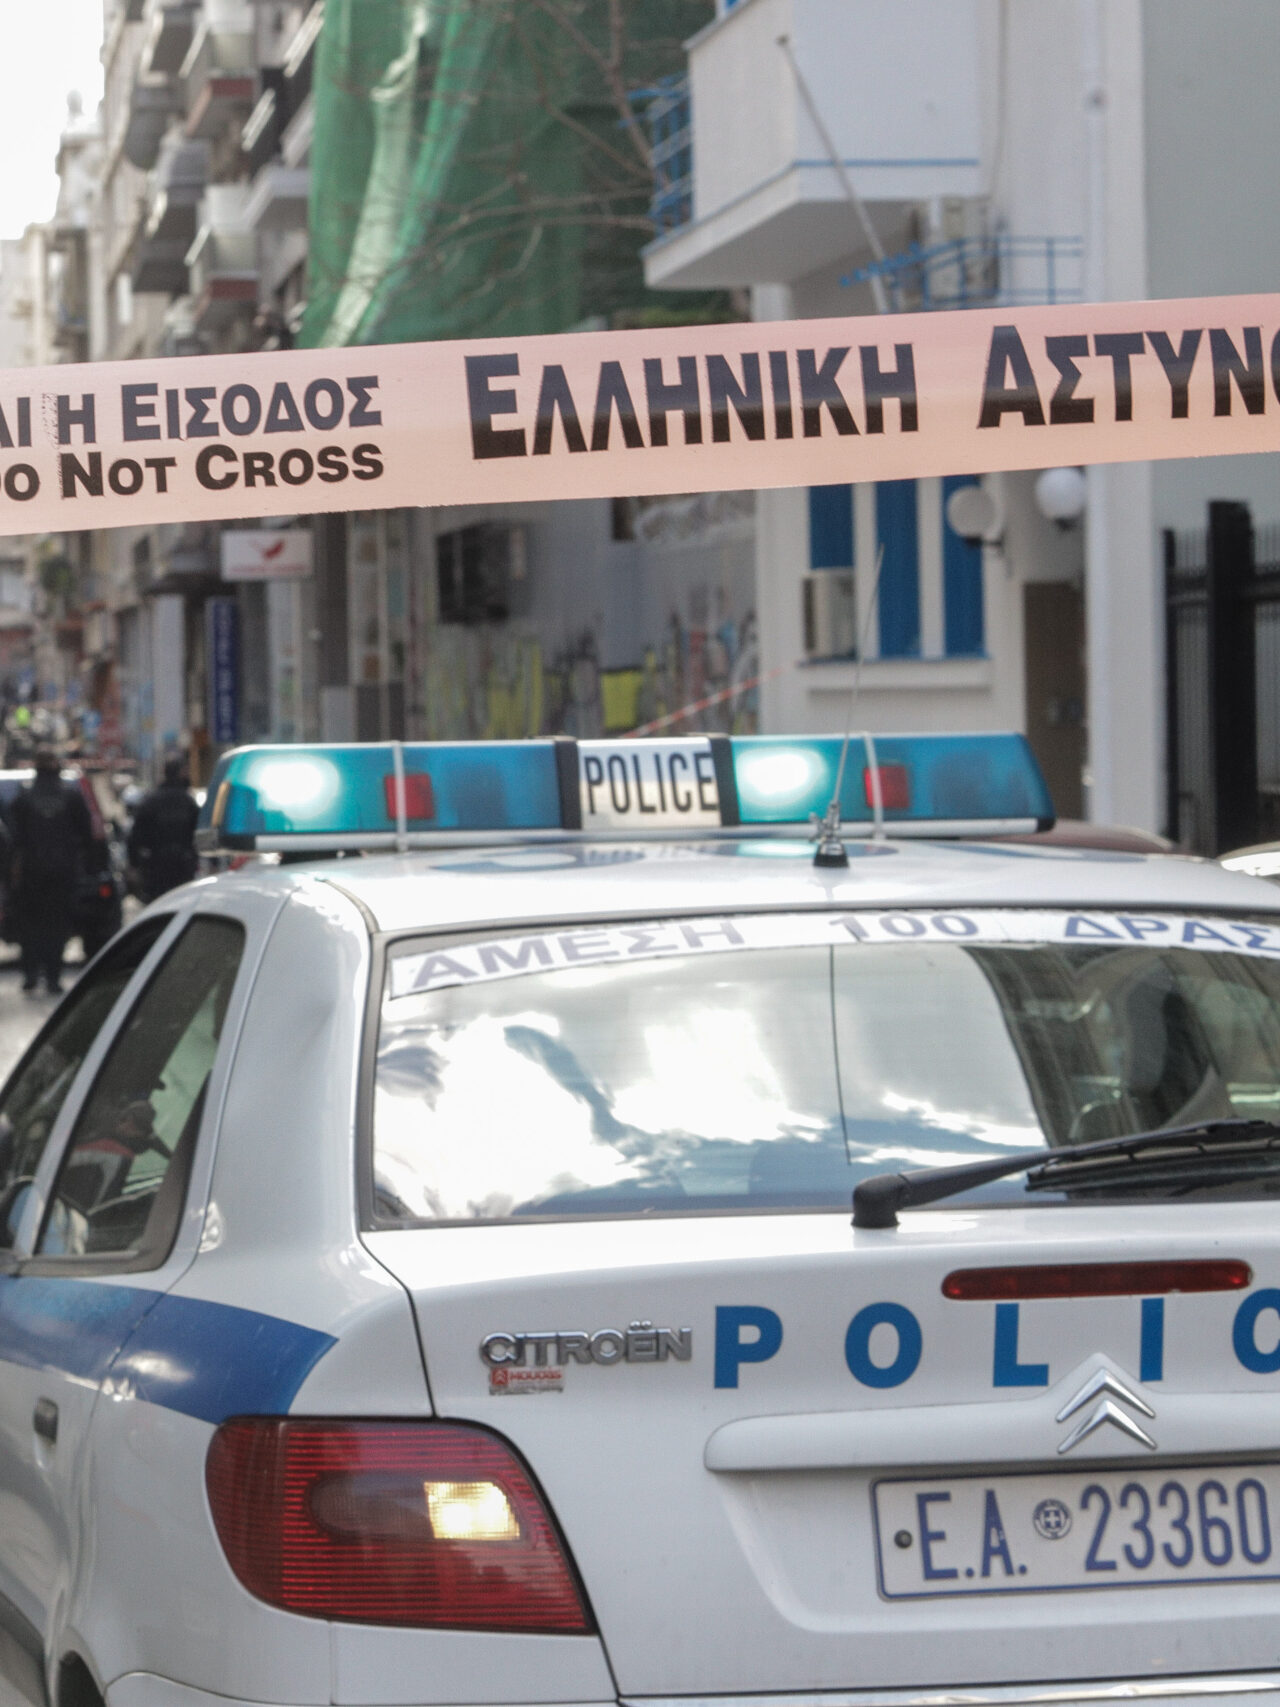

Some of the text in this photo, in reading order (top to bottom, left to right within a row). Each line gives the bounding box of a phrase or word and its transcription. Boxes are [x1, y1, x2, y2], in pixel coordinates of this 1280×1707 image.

[57, 393, 96, 445] Η
[121, 375, 382, 442] ΕΙΣΟΔΟΣ
[464, 344, 919, 459] ΕΛΛΗΝΙΚΗ
[584, 752, 719, 815] POLICE
[412, 914, 1280, 988] ΑΜΕΣΗ 100 ΔΡΑΣ
[480, 1320, 692, 1368] CITROËN
[714, 1288, 1280, 1389] POLIC
[1081, 1478, 1273, 1571] 23360
